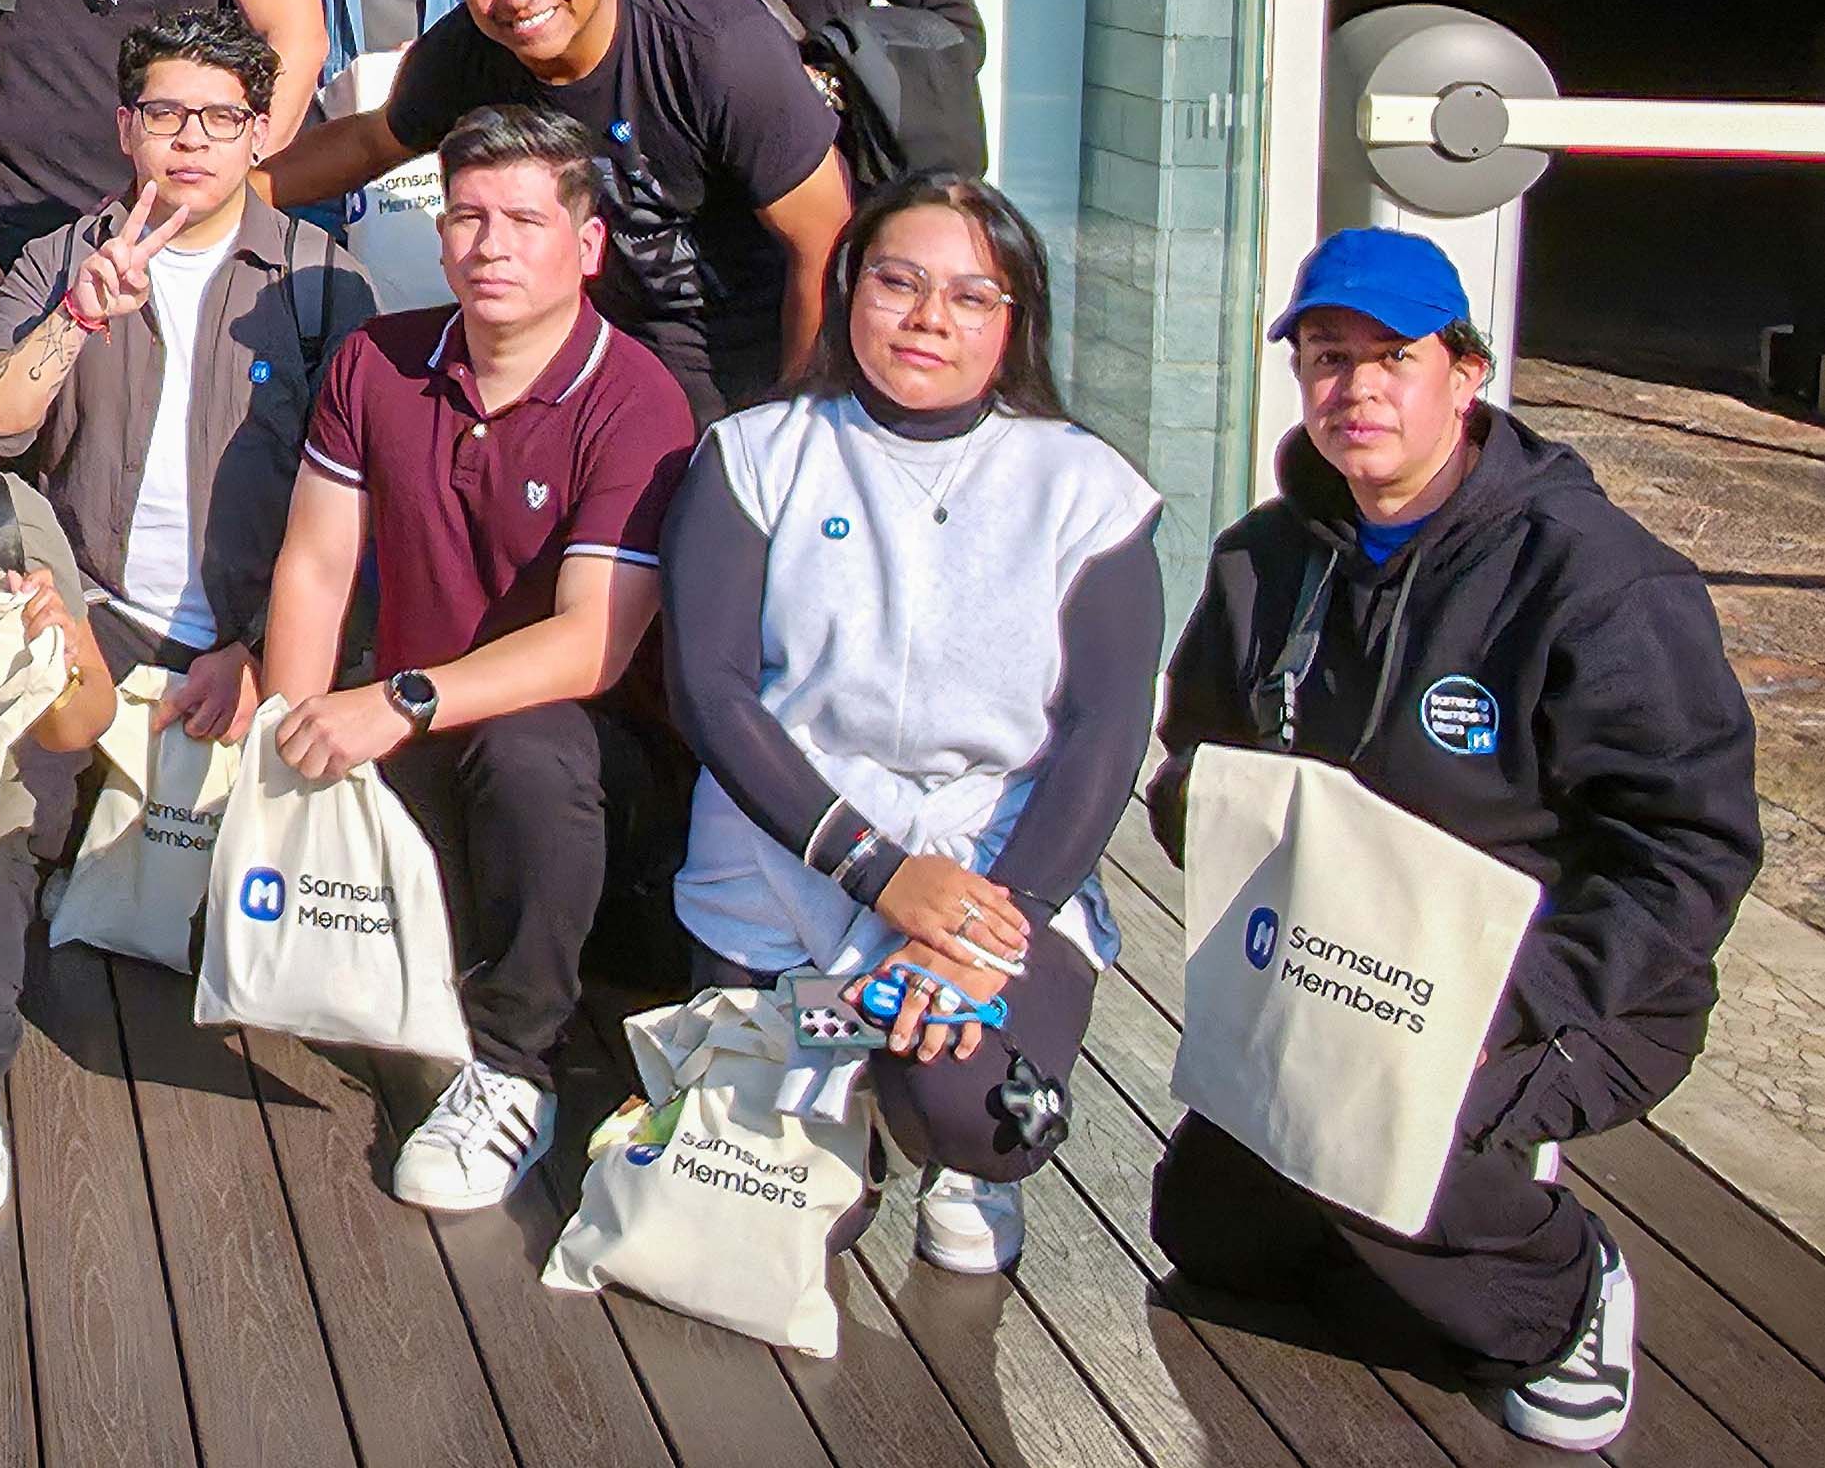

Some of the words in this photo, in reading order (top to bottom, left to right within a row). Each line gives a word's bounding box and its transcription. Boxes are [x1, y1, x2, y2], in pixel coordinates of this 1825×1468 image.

[375, 172, 440, 192] amsun
[379, 195, 441, 214] Membe
[298, 873, 395, 903] Samsun
[297, 905, 397, 936] Membe
[1288, 924, 1435, 1007] Samsung
[1280, 957, 1426, 1035] Members
[672, 1153, 808, 1209] Members
